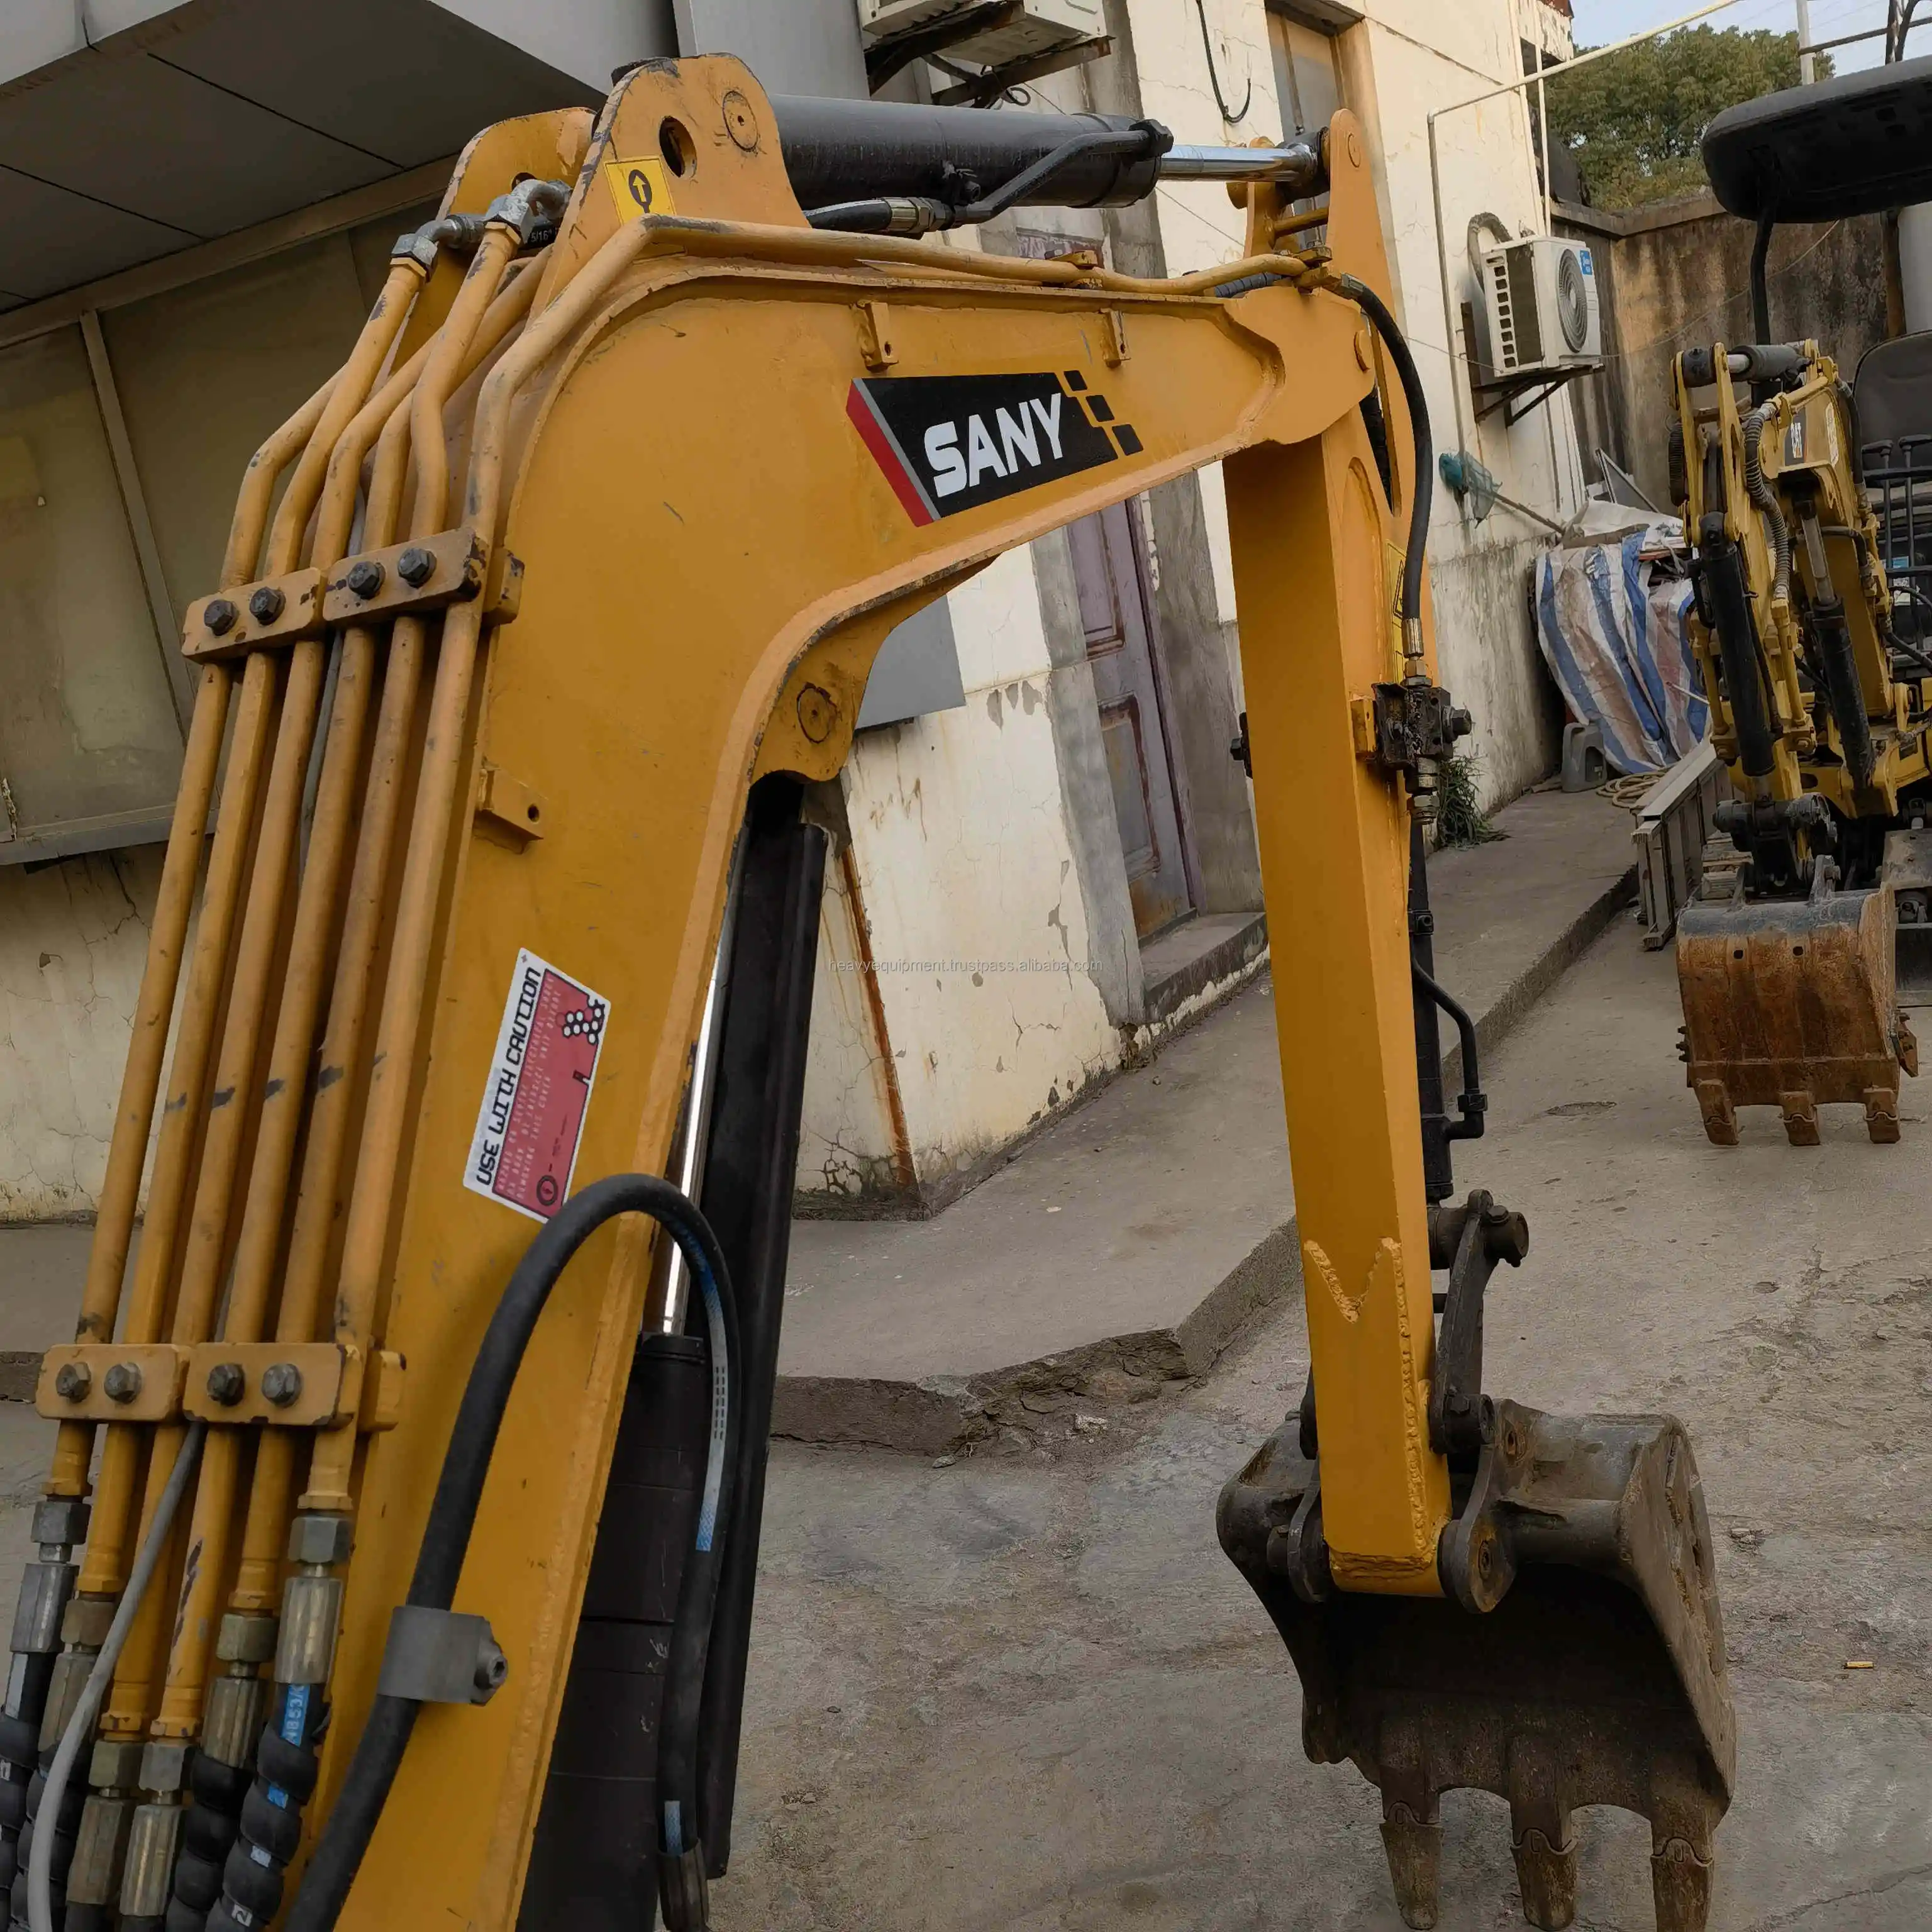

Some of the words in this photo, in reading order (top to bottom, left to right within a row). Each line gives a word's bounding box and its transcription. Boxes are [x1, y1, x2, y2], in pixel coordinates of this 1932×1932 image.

[924, 393, 1063, 498] SANY
[1790, 422, 1803, 458] CAT
[506, 967, 541, 1065] CAUTION
[487, 1068, 517, 1135] WITH
[476, 1139, 500, 1185] USE
